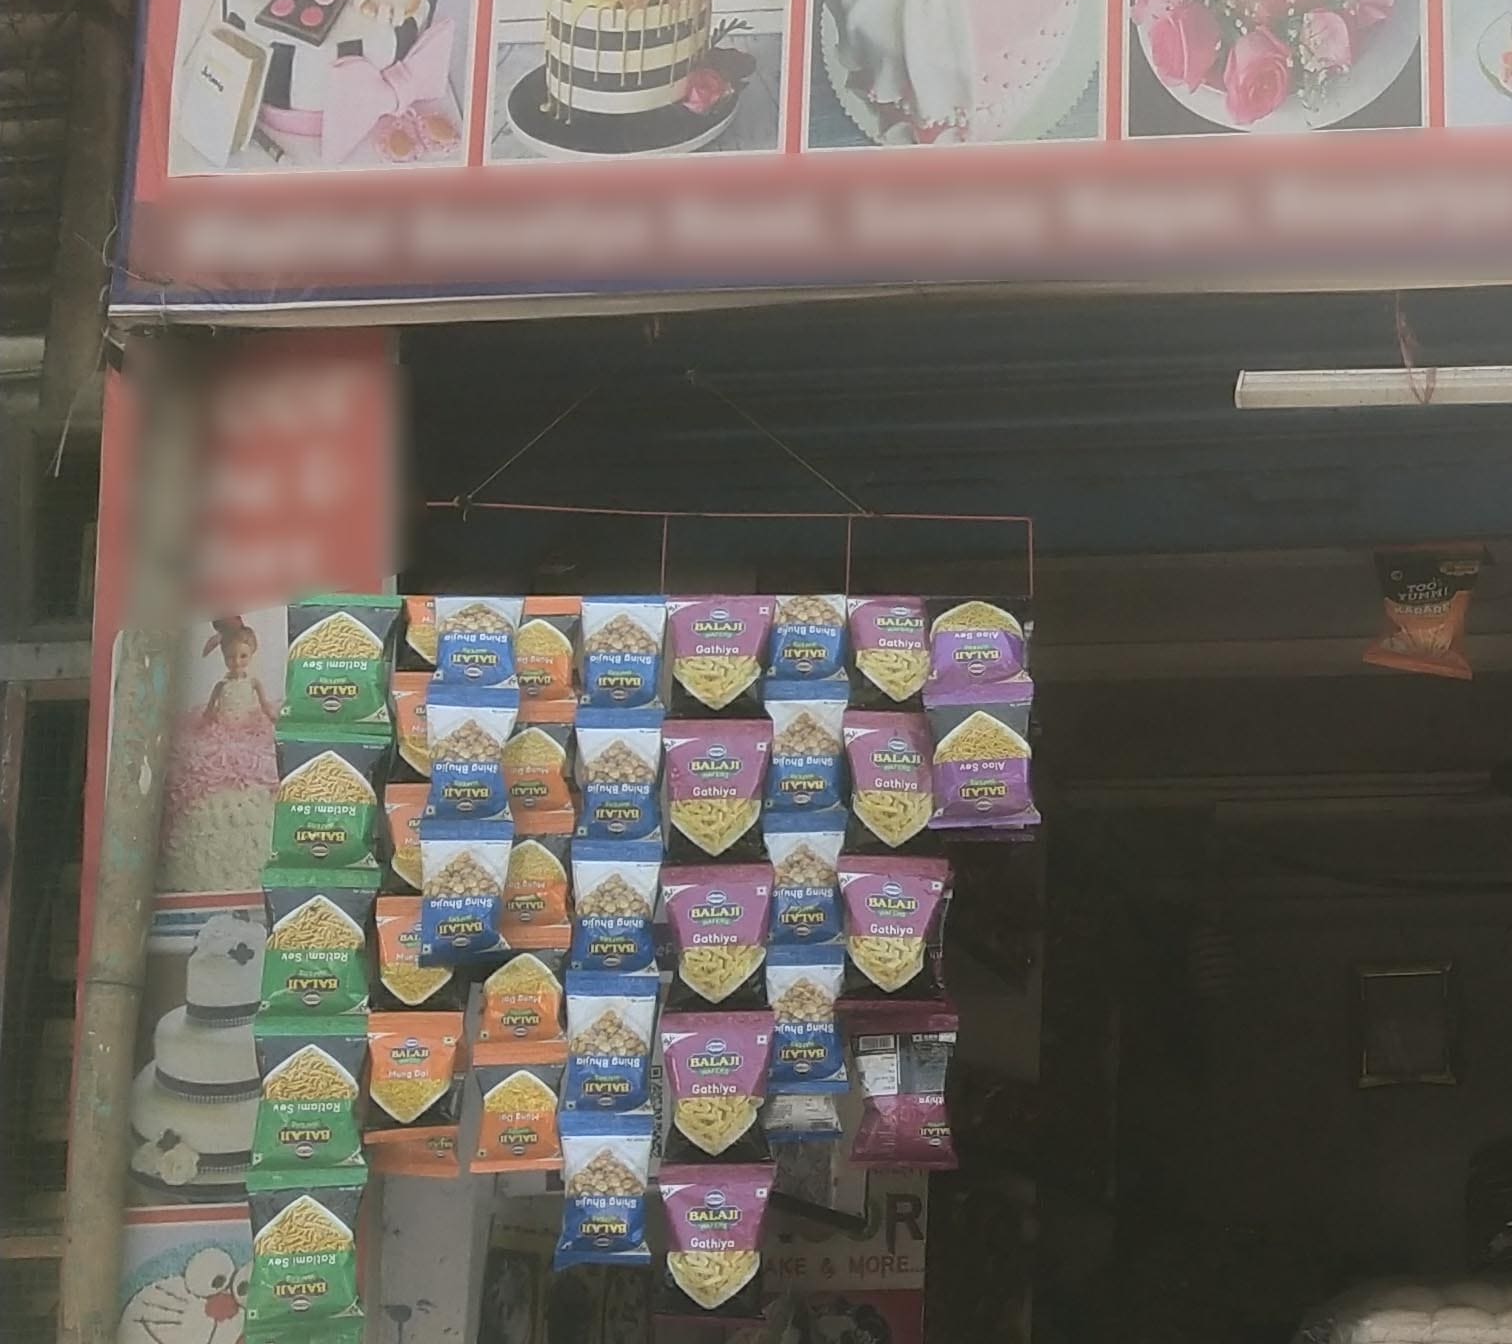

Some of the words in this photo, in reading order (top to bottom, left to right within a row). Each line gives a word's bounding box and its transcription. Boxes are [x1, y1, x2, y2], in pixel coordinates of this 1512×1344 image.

[1407, 582, 1436, 592] TOO
[694, 622, 742, 632] BALAJI
[877, 617, 923, 627] BALAJI
[444, 634, 476, 642] Bhujia
[479, 633, 508, 643] Shing
[878, 638, 922, 649] Gathiya
[695, 645, 739, 655] Gathiya
[783, 649, 826, 658] BALAJI
[452, 655, 496, 665] BALAJI
[590, 655, 621, 665] Bhujia
[624, 656, 652, 665] Shing
[956, 652, 999, 660] BALAJI
[303, 661, 323, 669] Sev
[326, 661, 367, 670] Ratlami
[598, 677, 642, 687] BALAJI
[309, 686, 358, 695] BALAJI
[806, 758, 834, 767] Shing
[873, 754, 921, 764] BALAJI
[435, 763, 468, 773] Bhujia
[690, 761, 740, 771] BALAJI
[959, 763, 978, 771] Sev
[981, 762, 1005, 771] Aloo
[781, 781, 824, 790] BALAJI
[874, 778, 917, 790] Gathiya
[445, 788, 489, 798] BALAJI
[587, 785, 619, 794] Bhujia
[622, 785, 649, 794] Shing
[692, 786, 737, 797] Gathiya
[961, 786, 1006, 797] BALAJI
[291, 806, 311, 815] Sev
[314, 806, 356, 815] Ratlami
[596, 808, 640, 819] BALAJI
[297, 831, 345, 841] BALAJI
[806, 888, 834, 897] Shing
[431, 899, 462, 909] Bhujia
[465, 899, 493, 907] Shing
[868, 898, 916, 909] BALAJI
[691, 907, 741, 918] BALAJI
[780, 912, 825, 923] BALAJI
[438, 922, 483, 933] BALAJI
[582, 919, 614, 929] Bhujia
[616, 919, 644, 928] Shing
[870, 924, 914, 935] Gathiya
[692, 933, 738, 945] Gathiya
[591, 943, 635, 953] BALAJI
[281, 953, 301, 961] Sev
[304, 953, 348, 961] Ratlami
[288, 979, 338, 989] BALAJI
[806, 1024, 834, 1033] Shing
[780, 1048, 825, 1058] BALAJI
[576, 1058, 607, 1067] Bhujia
[609, 1058, 640, 1067] Shing
[690, 1056, 740, 1067] BALAJI
[585, 1082, 630, 1093] BALAJI
[691, 1083, 737, 1095] Gathiya
[273, 1104, 294, 1113] Sev
[297, 1103, 341, 1113] Ratlami
[280, 1130, 331, 1141] BALAJI
[609, 1198, 637, 1208] Shing
[688, 1210, 739, 1221] BALAJI
[582, 1223, 627, 1234] BALAJI
[690, 1238, 735, 1250] Gathiya
[268, 1256, 289, 1266] Sev
[292, 1254, 336, 1265] Ratlami
[275, 1282, 327, 1295] BALAJI
